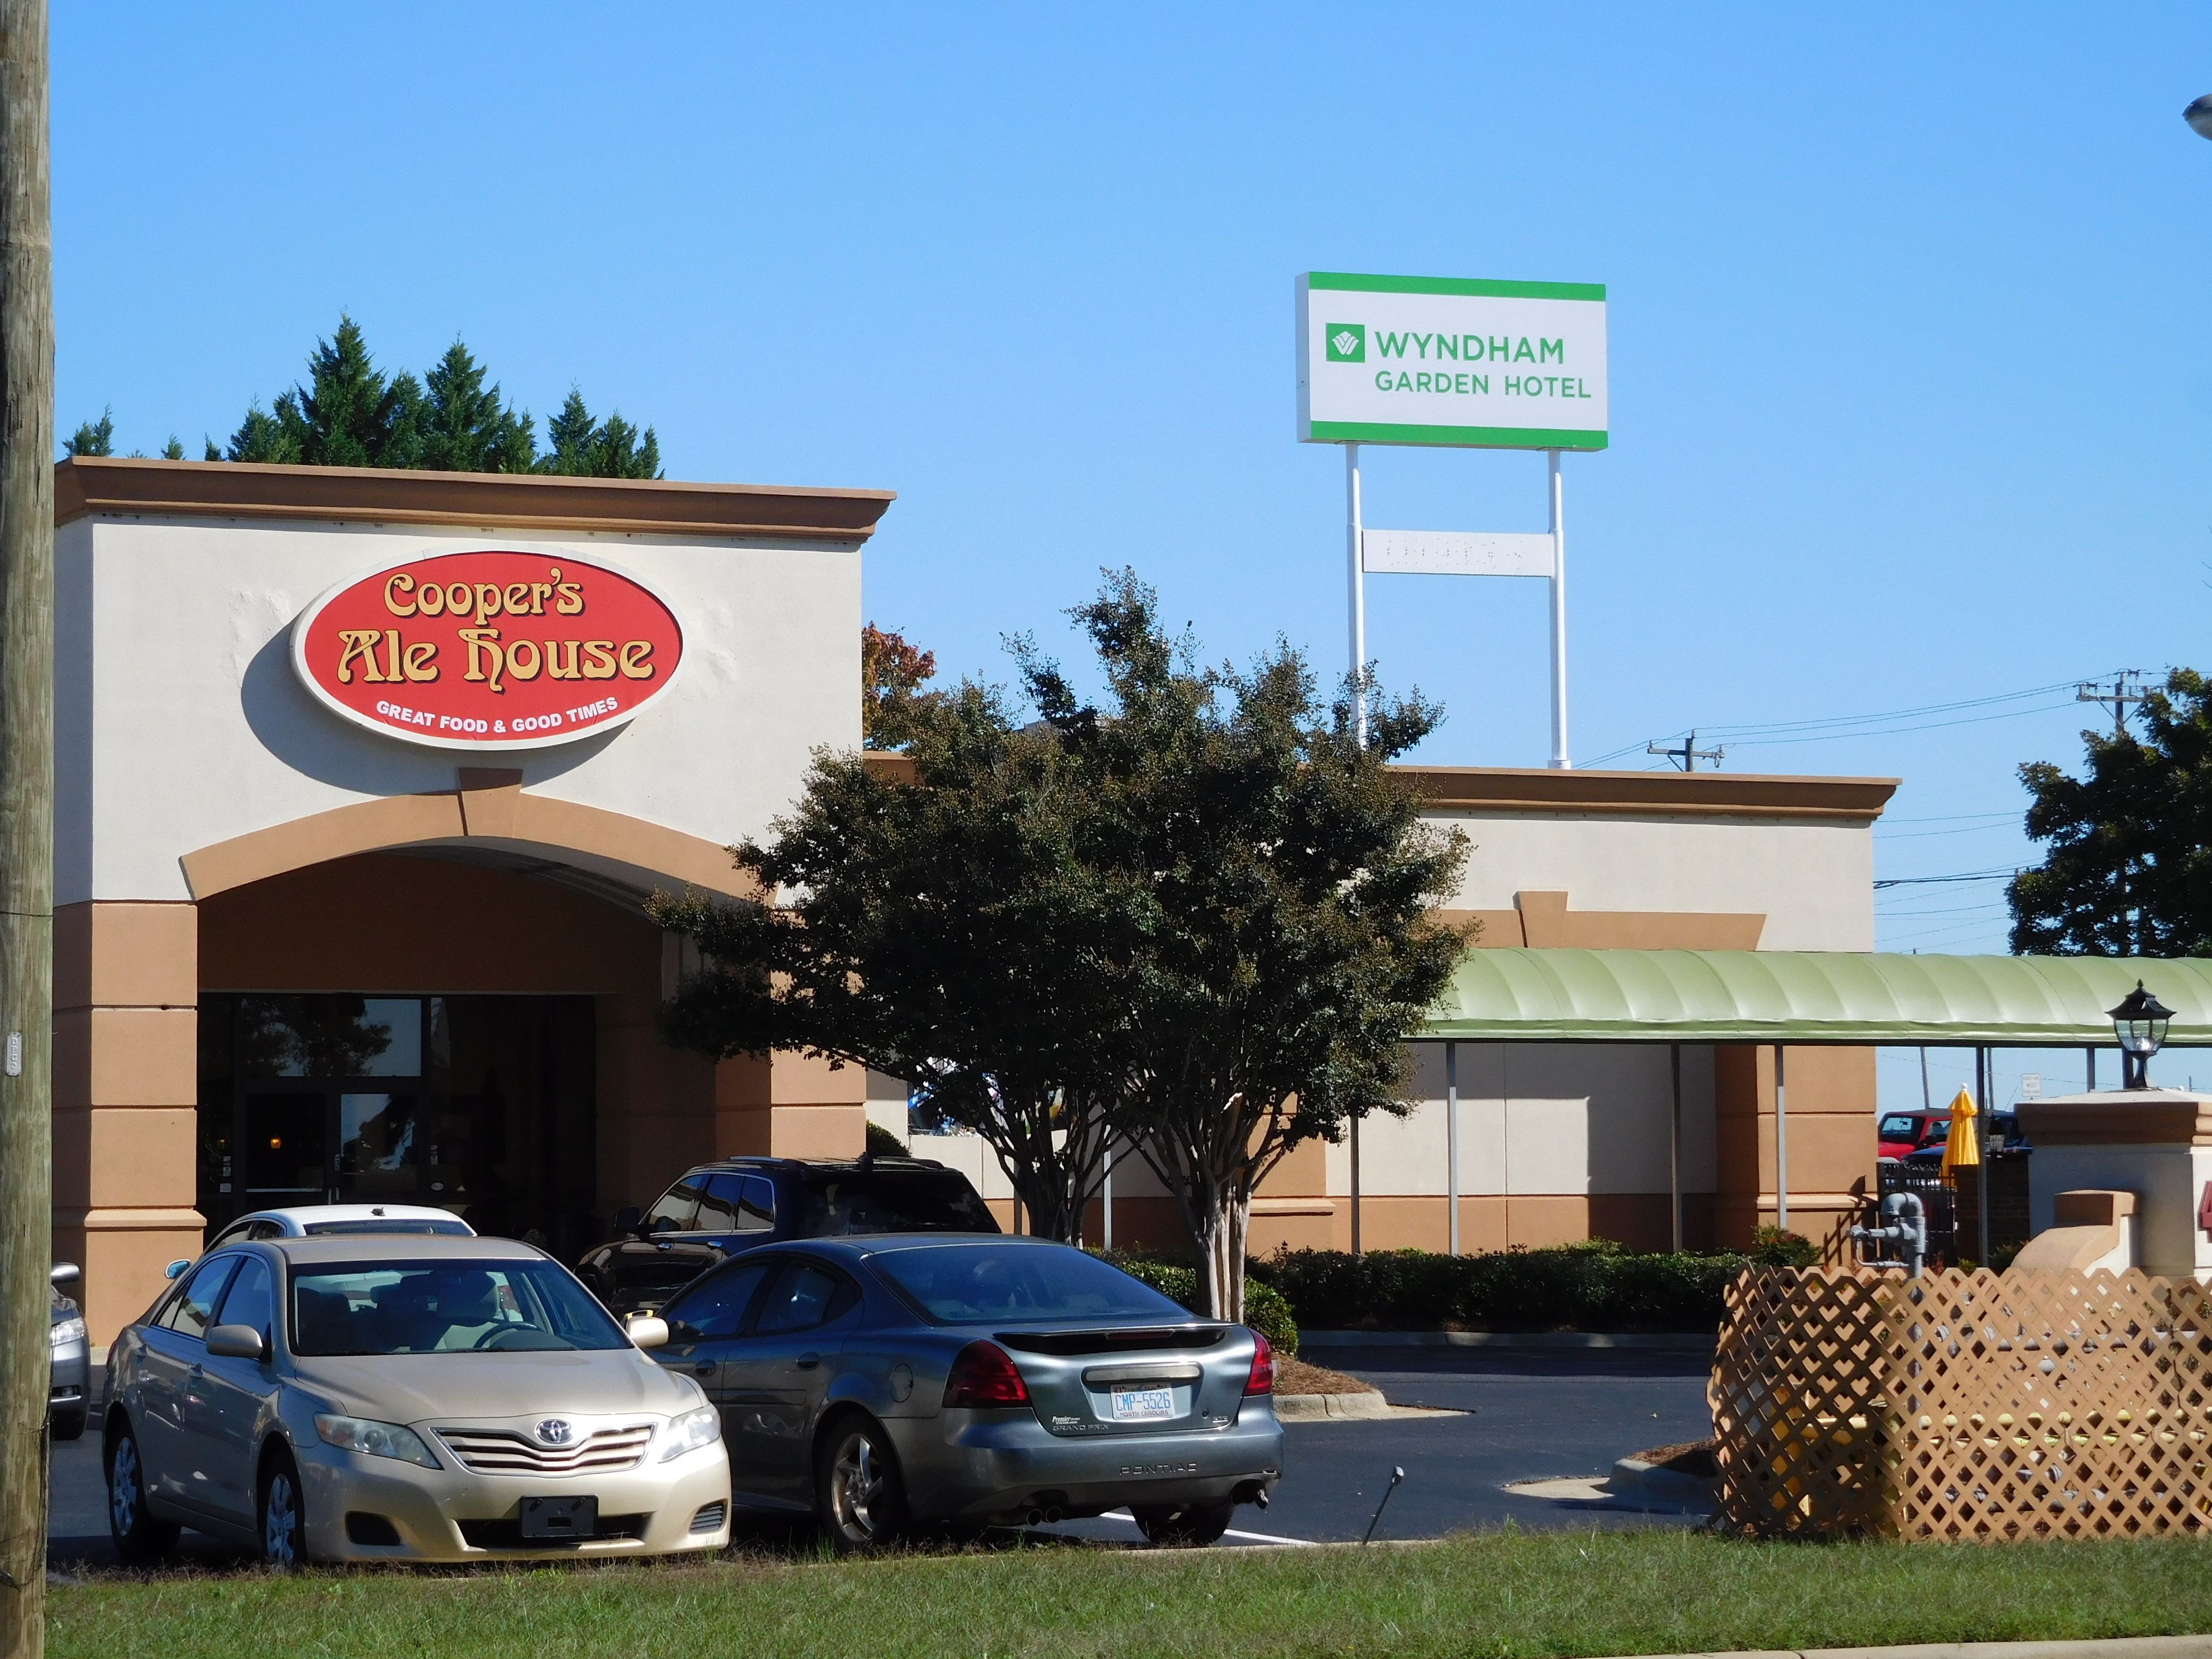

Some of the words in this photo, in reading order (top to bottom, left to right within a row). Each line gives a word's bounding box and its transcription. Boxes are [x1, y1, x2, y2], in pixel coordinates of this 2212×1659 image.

[1374, 331, 1564, 365] WYNDHAM
[1374, 370, 1489, 395] GARDEN
[1504, 375, 1592, 399] HOTEL
[384, 567, 585, 626] Cooper's
[337, 628, 441, 684] Ale
[458, 628, 656, 694] House
[376, 700, 435, 727] GREAT
[439, 715, 488, 733] FOOD
[493, 720, 507, 733] &
[512, 713, 563, 733] GOOD
[566, 696, 619, 724] TIMES
[1115, 1392, 1171, 1411] CMP-5526
[1119, 1463, 1197, 1475] PONTIAC
